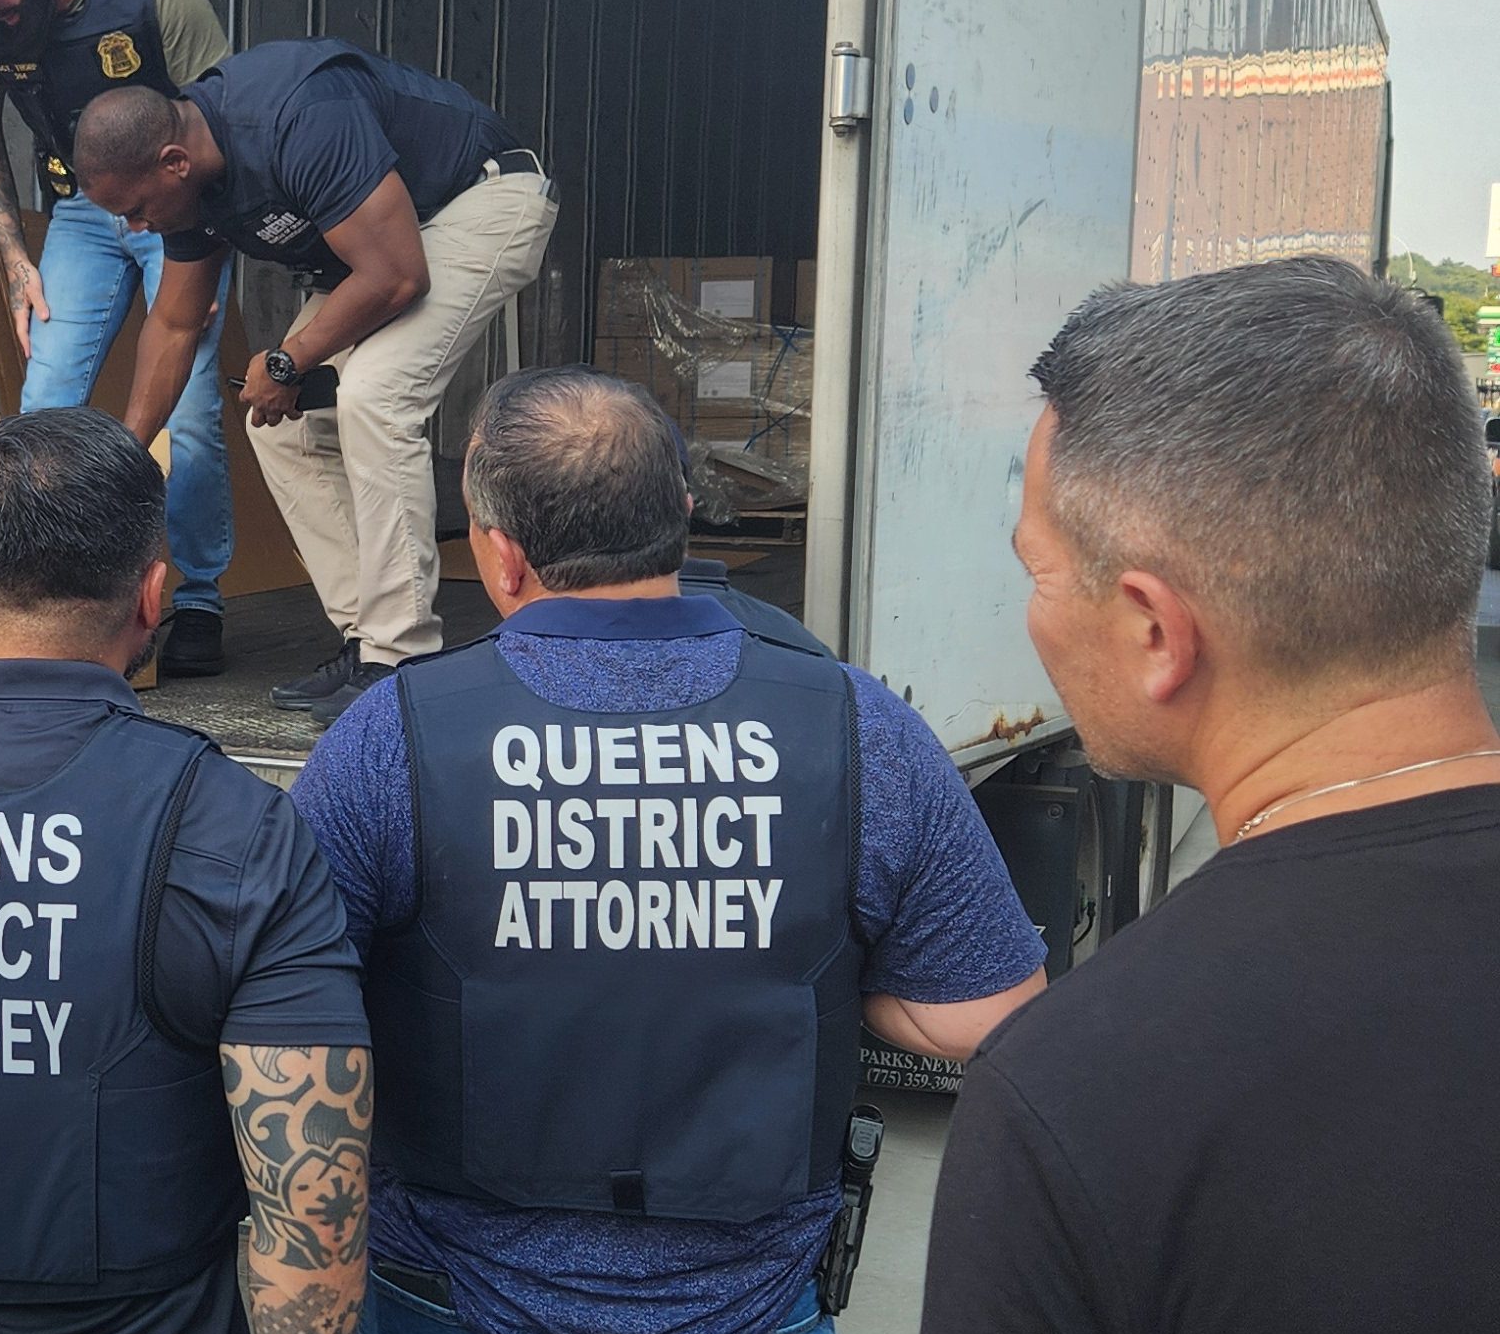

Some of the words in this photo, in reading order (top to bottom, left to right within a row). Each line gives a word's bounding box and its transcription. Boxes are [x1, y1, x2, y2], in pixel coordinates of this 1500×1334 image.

[492, 720, 780, 791] QUEENS
[493, 795, 782, 869] DISTRICT
[495, 879, 784, 950] ATTORNEY
[860, 1048, 918, 1073] PARKS,
[920, 1056, 965, 1075] NEVA
[867, 1068, 901, 1088] (775)
[904, 1072, 964, 1091] 359-3900
